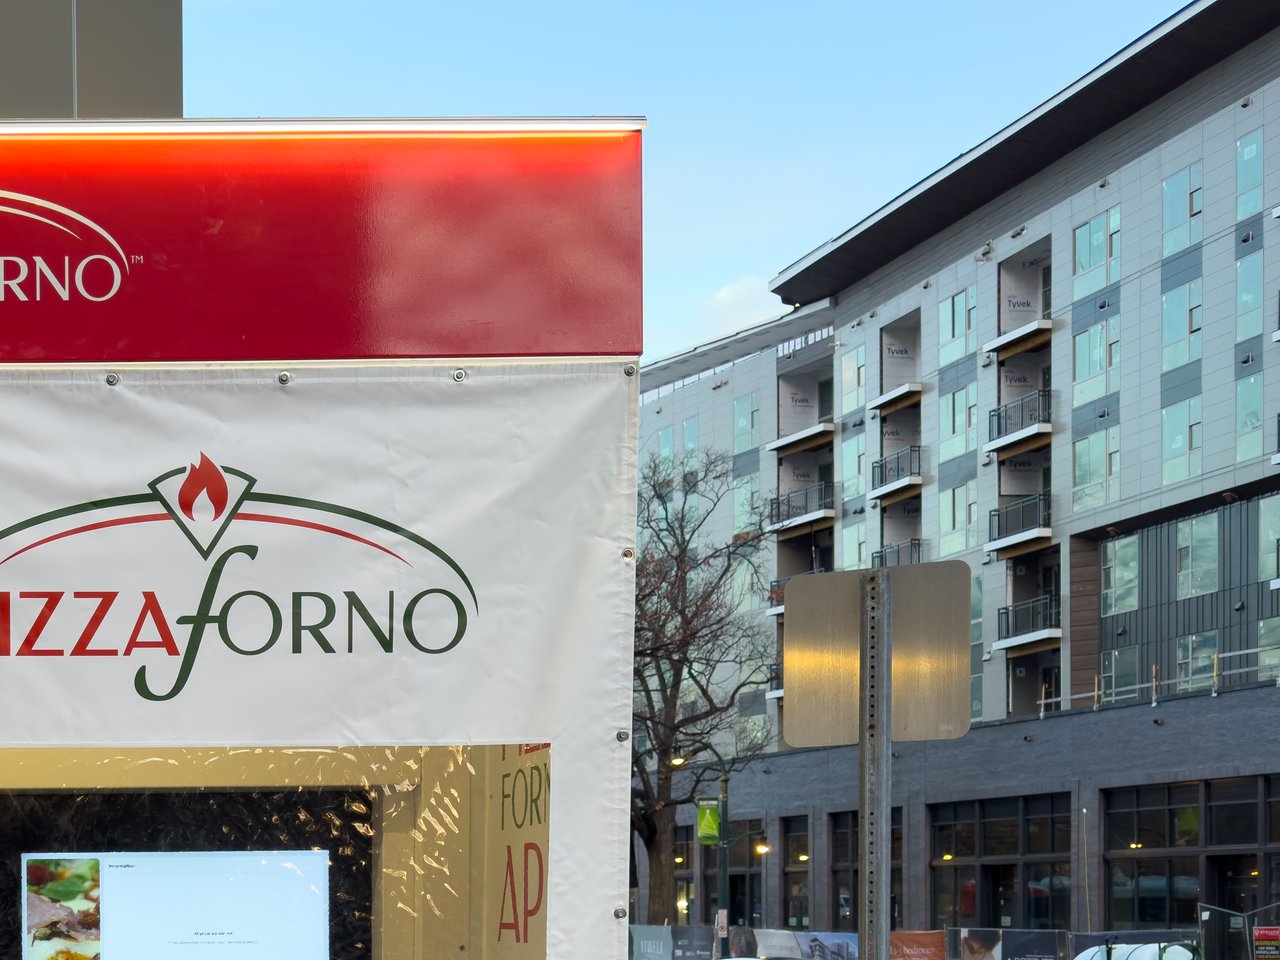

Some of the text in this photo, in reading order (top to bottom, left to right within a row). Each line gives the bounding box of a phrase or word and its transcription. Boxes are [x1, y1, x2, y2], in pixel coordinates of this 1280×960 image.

[1008, 299, 1032, 309] Tyvek
[1004, 374, 1028, 383] Tyvek
[882, 429, 900, 437] yvek
